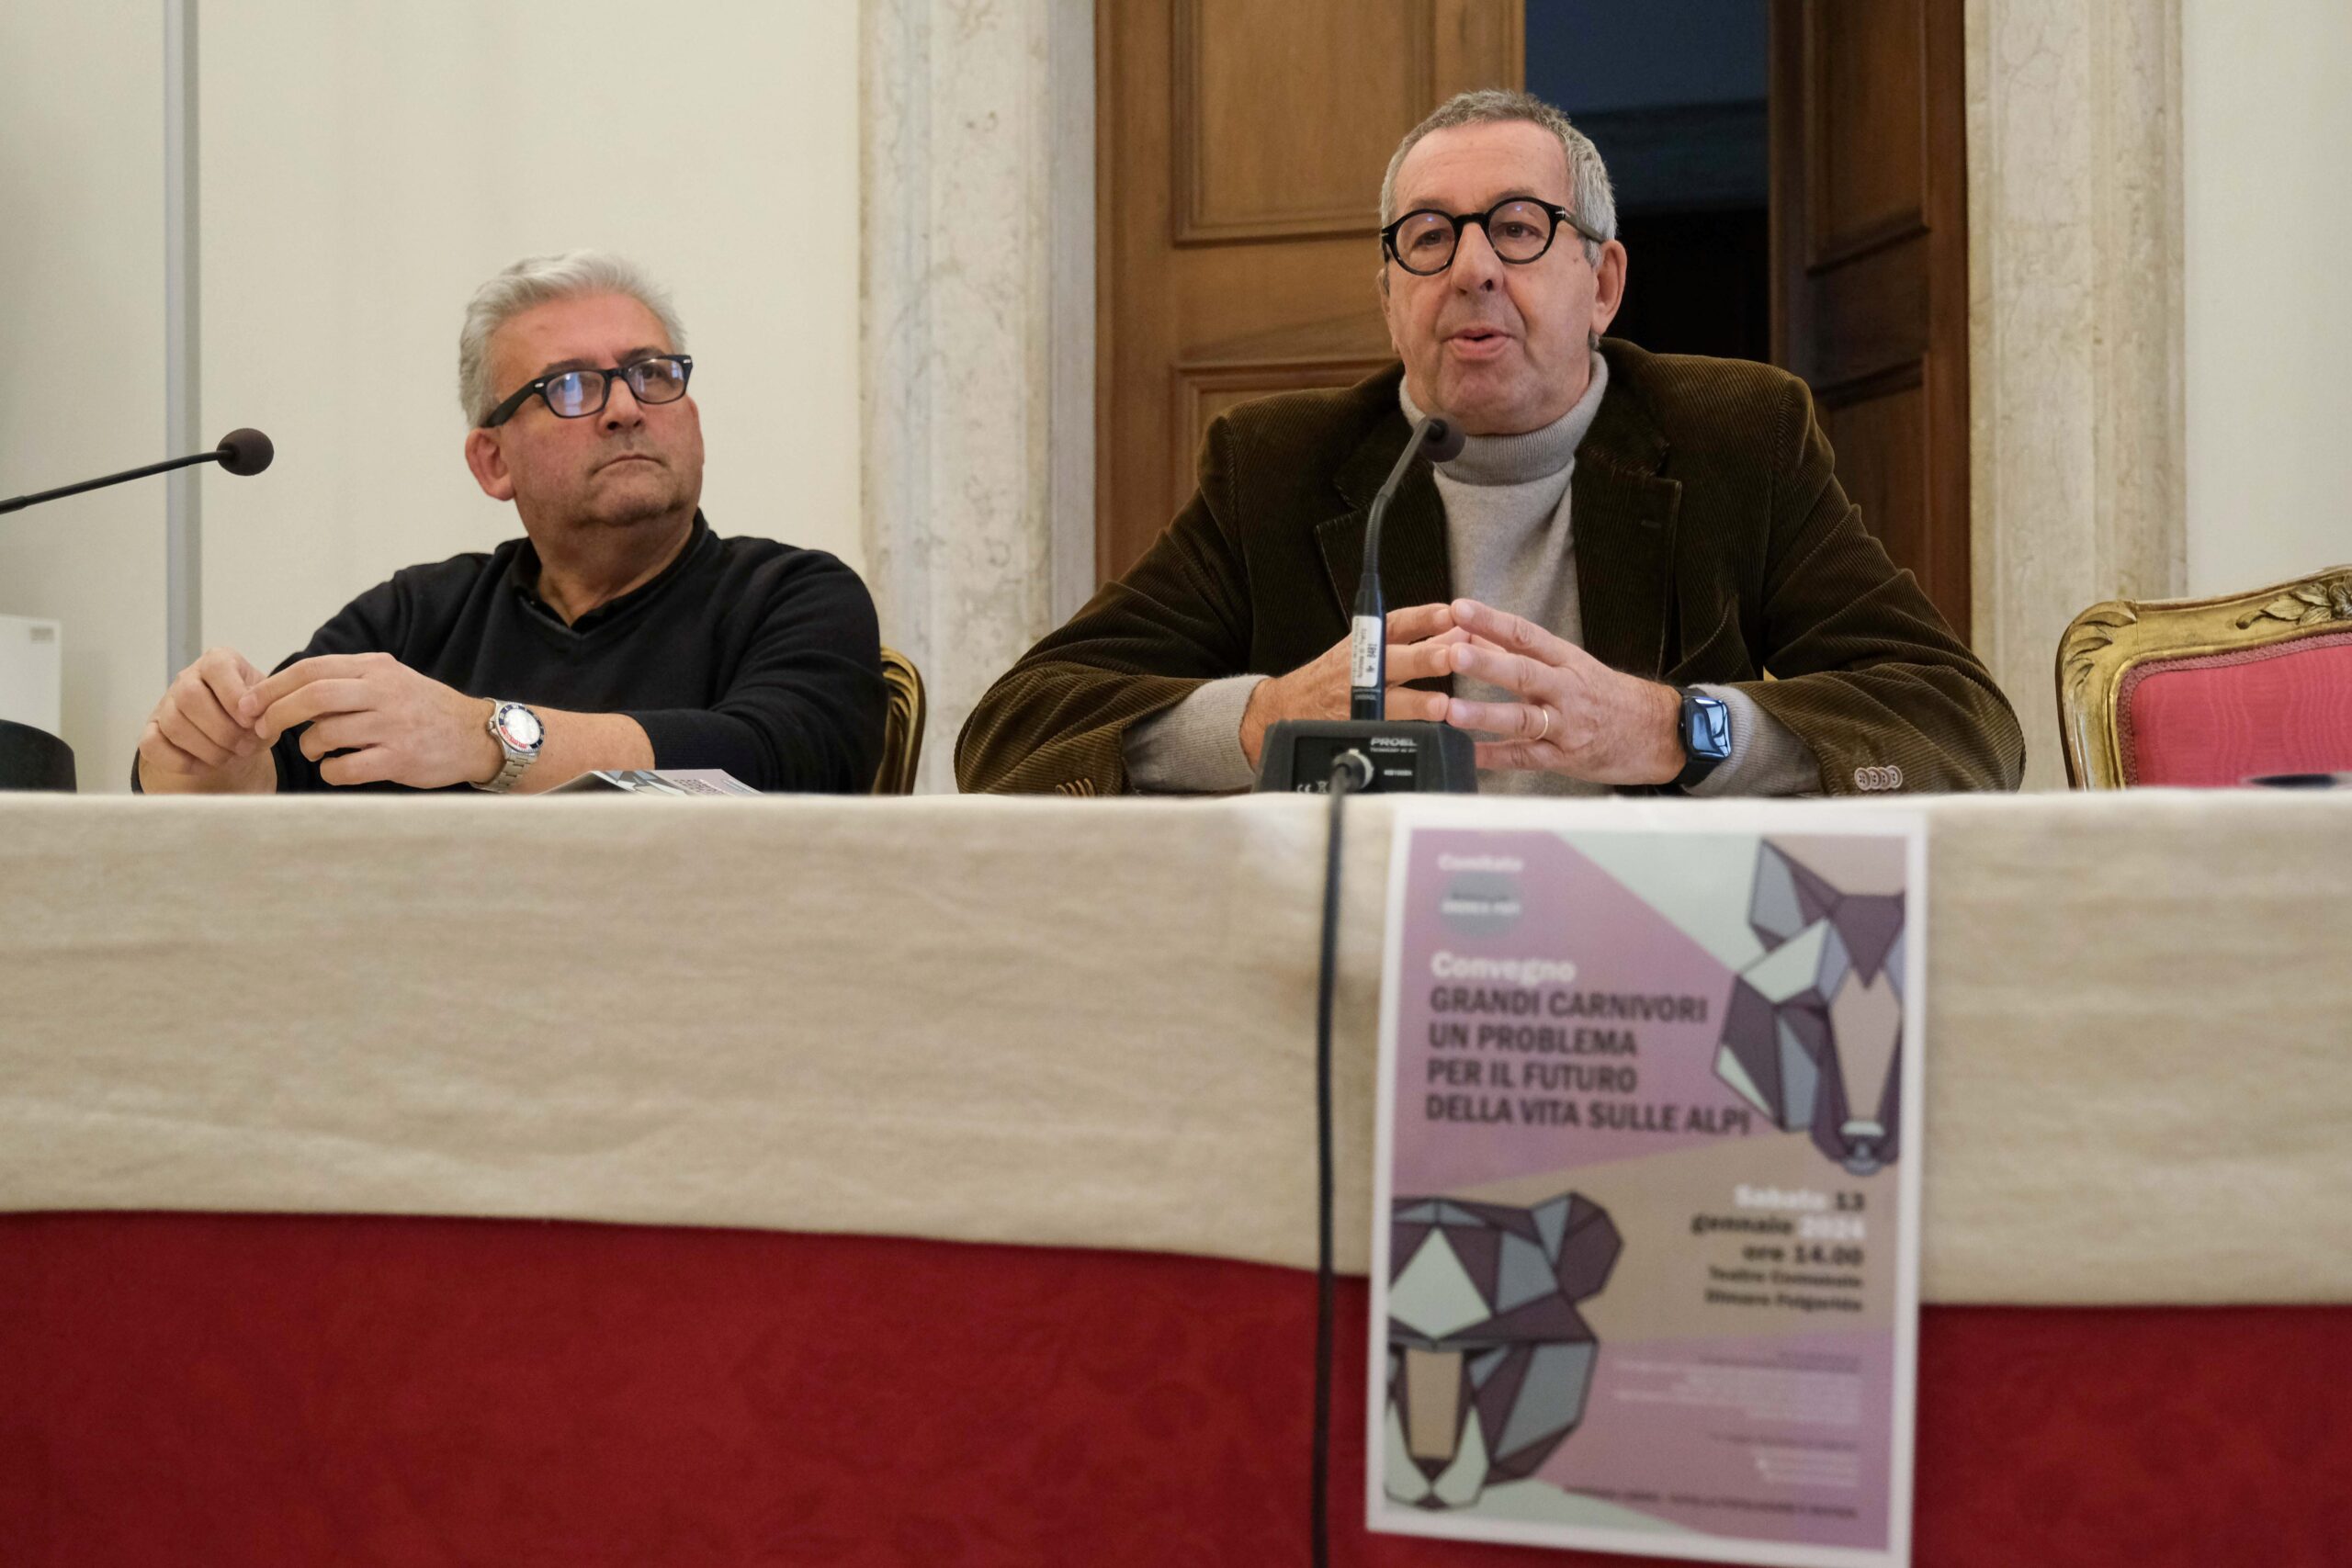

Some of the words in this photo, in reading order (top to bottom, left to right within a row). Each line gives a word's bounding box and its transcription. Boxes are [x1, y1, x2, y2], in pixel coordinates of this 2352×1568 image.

[1370, 738, 1417, 747] PROEL
[1430, 950, 1577, 987] Convegno
[1430, 986, 1541, 1016] GRANDI
[1549, 990, 1708, 1022] CARNIVORI
[1428, 1021, 1469, 1050] UN
[1476, 1023, 1638, 1055] PROBLEMA
[1427, 1058, 1482, 1088] PER
[1488, 1061, 1516, 1089] IL
[1522, 1062, 1638, 1093] FUTURO
[1426, 1093, 1513, 1123] DELLA
[1519, 1098, 1581, 1128] VITA
[1588, 1100, 1679, 1132] SULLE
[1686, 1105, 1751, 1135] ALPI
[1834, 1191, 1866, 1213] 13
[1690, 1213, 1794, 1237] gennaio
[1742, 1246, 1786, 1264] ore
[1793, 1246, 1864, 1267] 14.00
